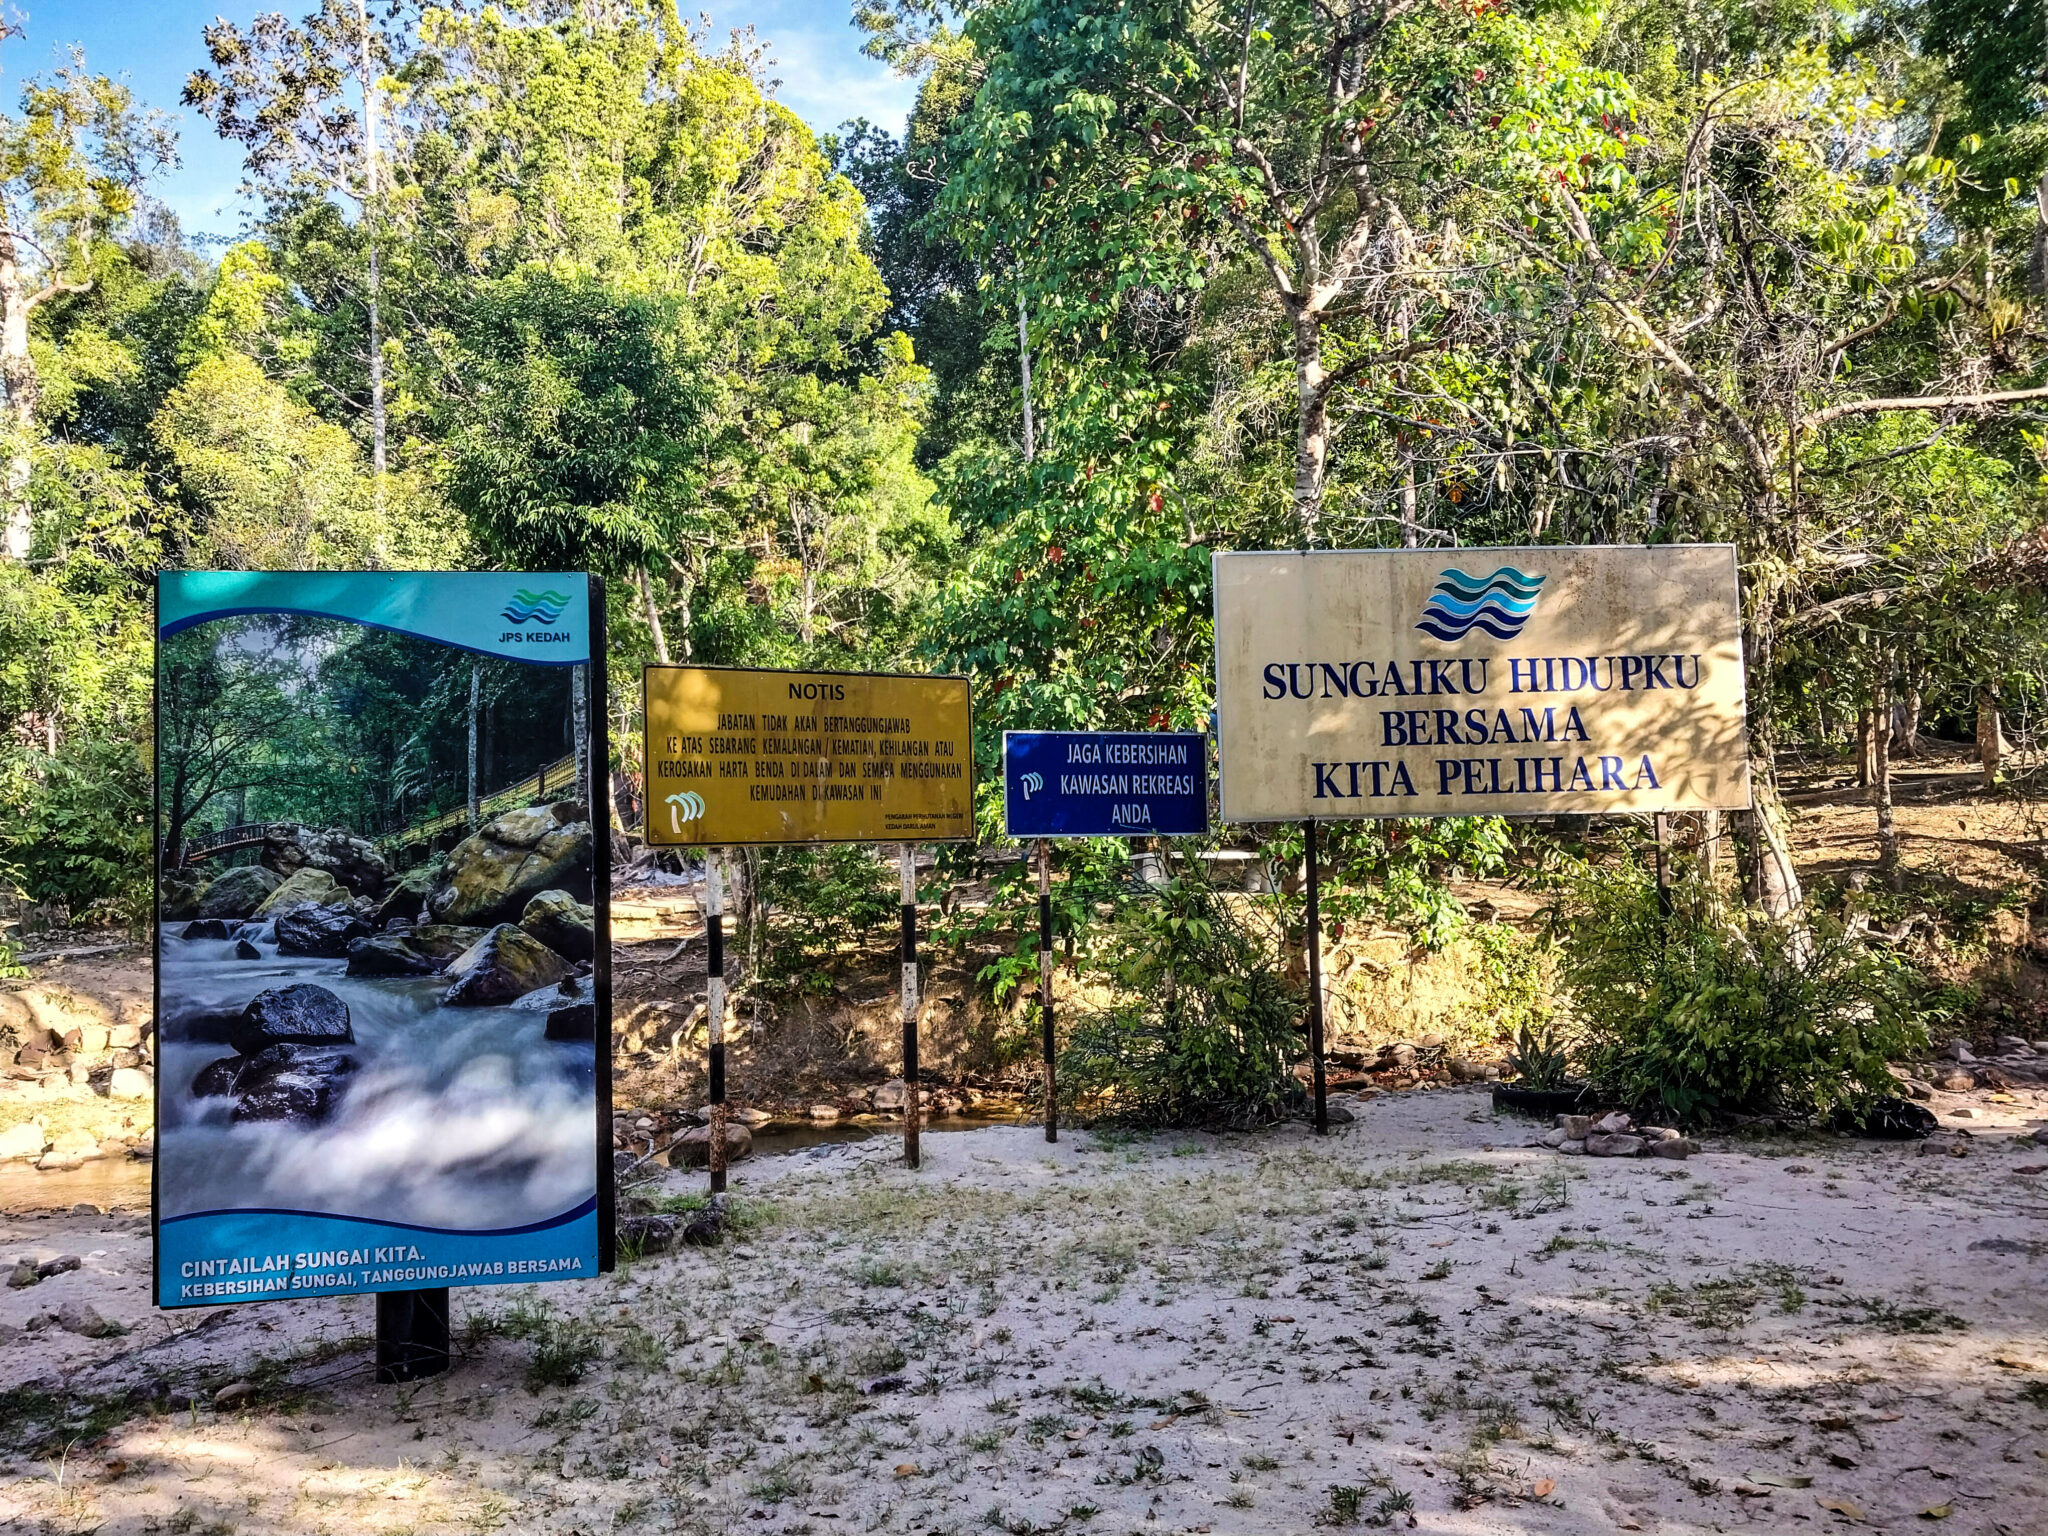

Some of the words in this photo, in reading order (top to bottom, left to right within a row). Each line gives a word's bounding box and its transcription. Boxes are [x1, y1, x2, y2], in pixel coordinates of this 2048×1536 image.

[498, 632, 522, 642] JPS
[526, 632, 570, 642] KEDAH
[1263, 658, 1490, 700] SUNGAIKU
[1507, 654, 1701, 693] HIDUPKU
[788, 683, 845, 700] NOTIS
[717, 714, 755, 731] JABATAN
[762, 714, 788, 731] TIDAK
[794, 715, 817, 732] AKAN
[824, 716, 911, 734] BERTANGGUNGJAWAB
[1379, 706, 1591, 746] BERSAMA
[666, 736, 677, 753] KE
[681, 736, 703, 753] ATAS
[709, 737, 756, 754] SEBARANG
[762, 738, 822, 755] KEMALANGAN
[825, 738, 829, 758] /
[832, 739, 877, 758] KEMATIAN,
[879, 740, 929, 757] KEHILANGAN
[934, 741, 954, 757] ATAU
[1067, 743, 1102, 764] JAGA
[1105, 744, 1187, 765] KEBERSIHAN
[658, 760, 712, 778] KEROSAKAN
[719, 761, 749, 778] HARTA
[755, 761, 784, 778] BENDA
[791, 762, 800, 778] DI
[803, 762, 833, 778] DALAM
[839, 762, 856, 778] DAN
[862, 762, 895, 778] SEMASA
[900, 762, 962, 779] MENGGUNAKAN
[1312, 760, 1419, 799] KITA
[1435, 754, 1662, 796] PELIHARA
[750, 784, 806, 801] KEMUDAHAN
[812, 784, 820, 801] DI
[824, 784, 864, 801] KAWASAN
[870, 784, 882, 801] INI
[1060, 774, 1128, 795] KAWASAN
[1132, 775, 1194, 795] REKREASI
[1111, 804, 1151, 824] ANDA
[181, 1254, 290, 1278] CINTAILAH
[295, 1248, 369, 1270] SUNGAI
[374, 1245, 426, 1264] KITA.
[181, 1276, 288, 1298] KEBERSIHAN
[291, 1272, 357, 1289] SUNGAI,
[361, 1261, 504, 1284] TANGGUNGJAWAB
[507, 1256, 582, 1274] BERSAMA
